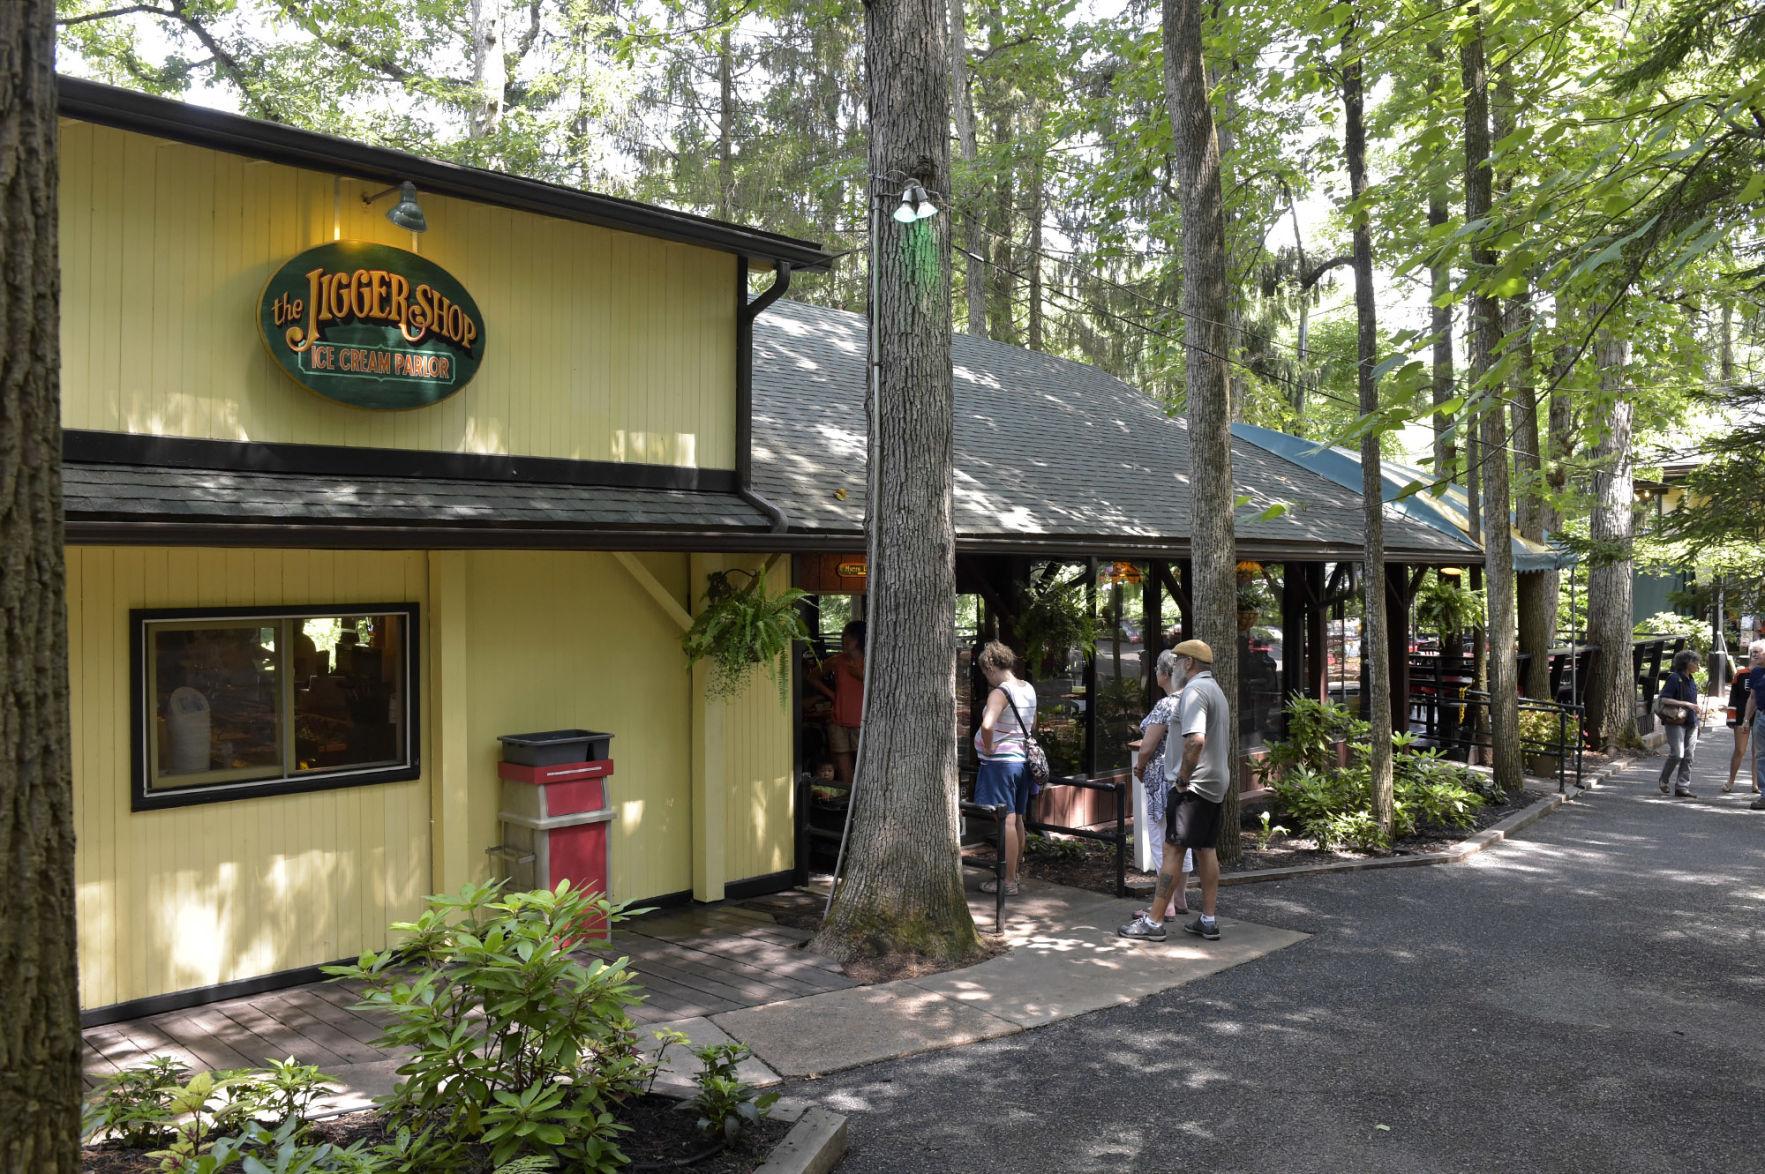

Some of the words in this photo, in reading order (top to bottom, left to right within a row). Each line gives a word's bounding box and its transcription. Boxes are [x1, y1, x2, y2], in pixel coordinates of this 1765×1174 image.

[271, 290, 304, 326] the
[286, 267, 426, 352] JIGGER
[408, 284, 477, 349] SHOP
[311, 345, 336, 370] ICE
[339, 347, 391, 375] CREAM
[394, 352, 450, 379] PARLOR
